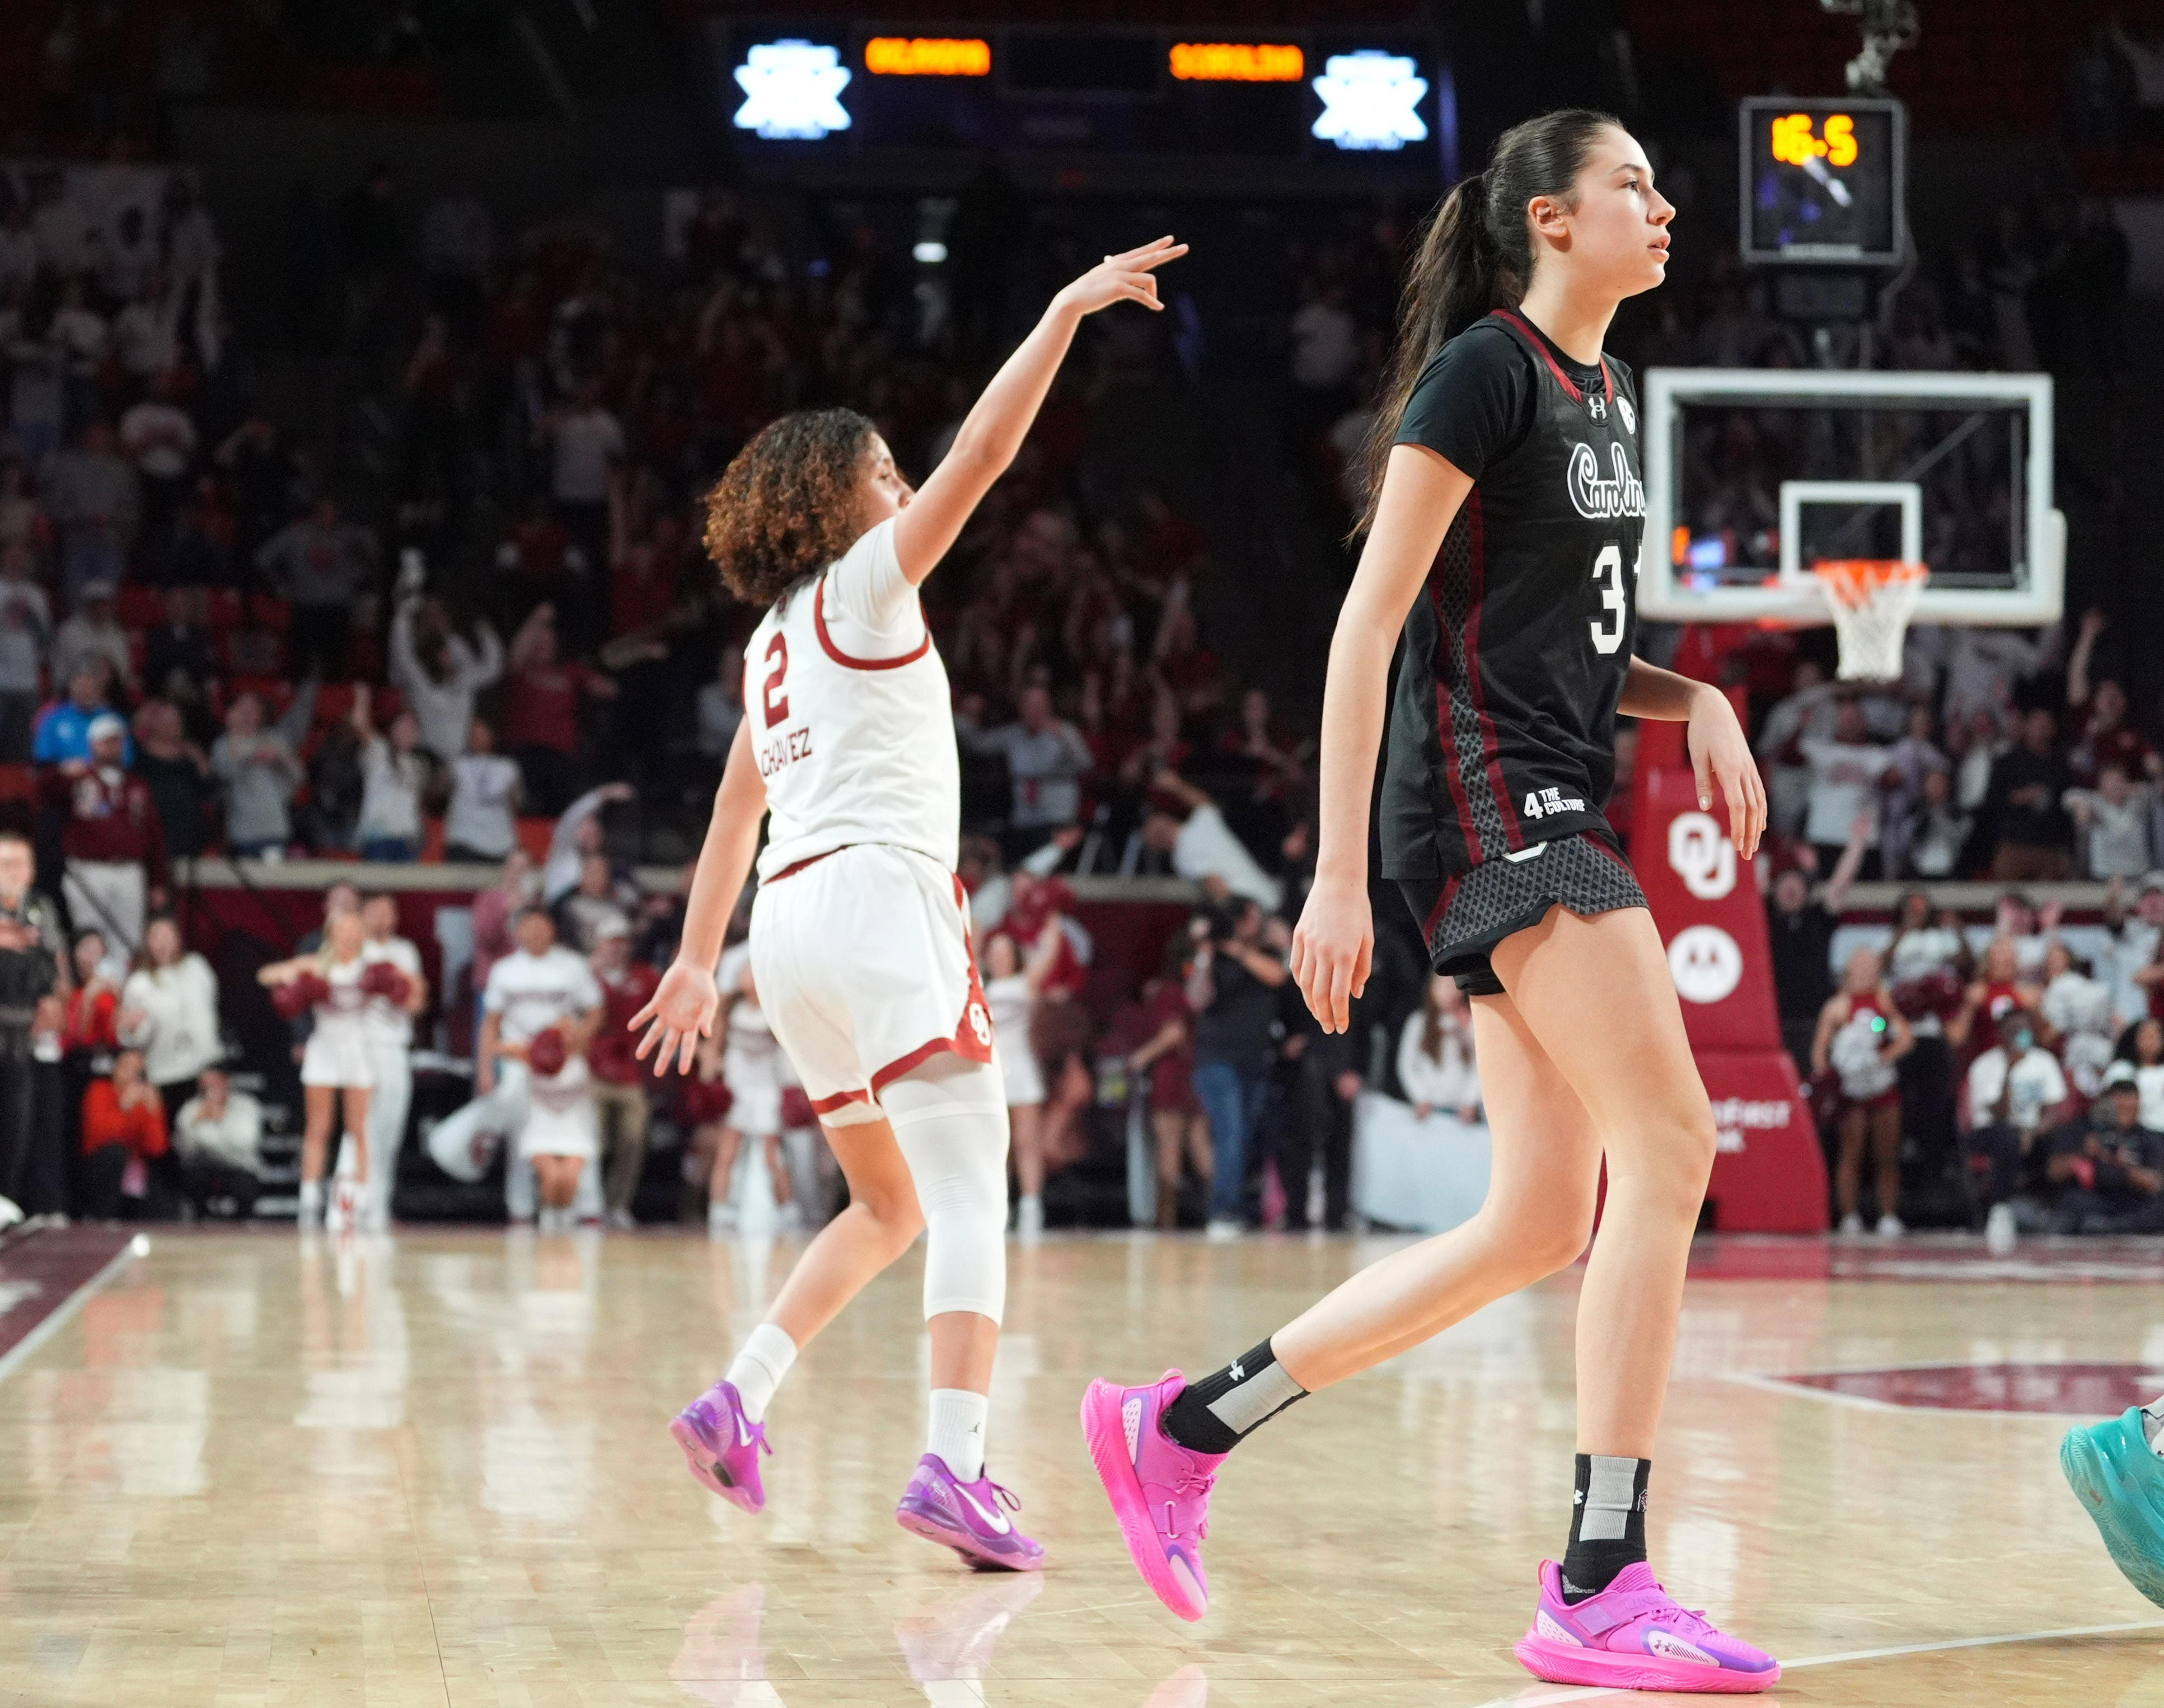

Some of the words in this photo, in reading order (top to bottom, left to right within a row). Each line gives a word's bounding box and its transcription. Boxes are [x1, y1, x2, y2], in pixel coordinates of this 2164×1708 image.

[1567, 442, 1645, 519] Carolin
[1590, 545, 1642, 654] 3
[764, 630, 789, 730] 2
[762, 727, 812, 777] CHAVEZ
[1524, 792, 1543, 819] 4
[1538, 787, 1561, 803] THE
[1544, 799, 1585, 815] CULTURE
